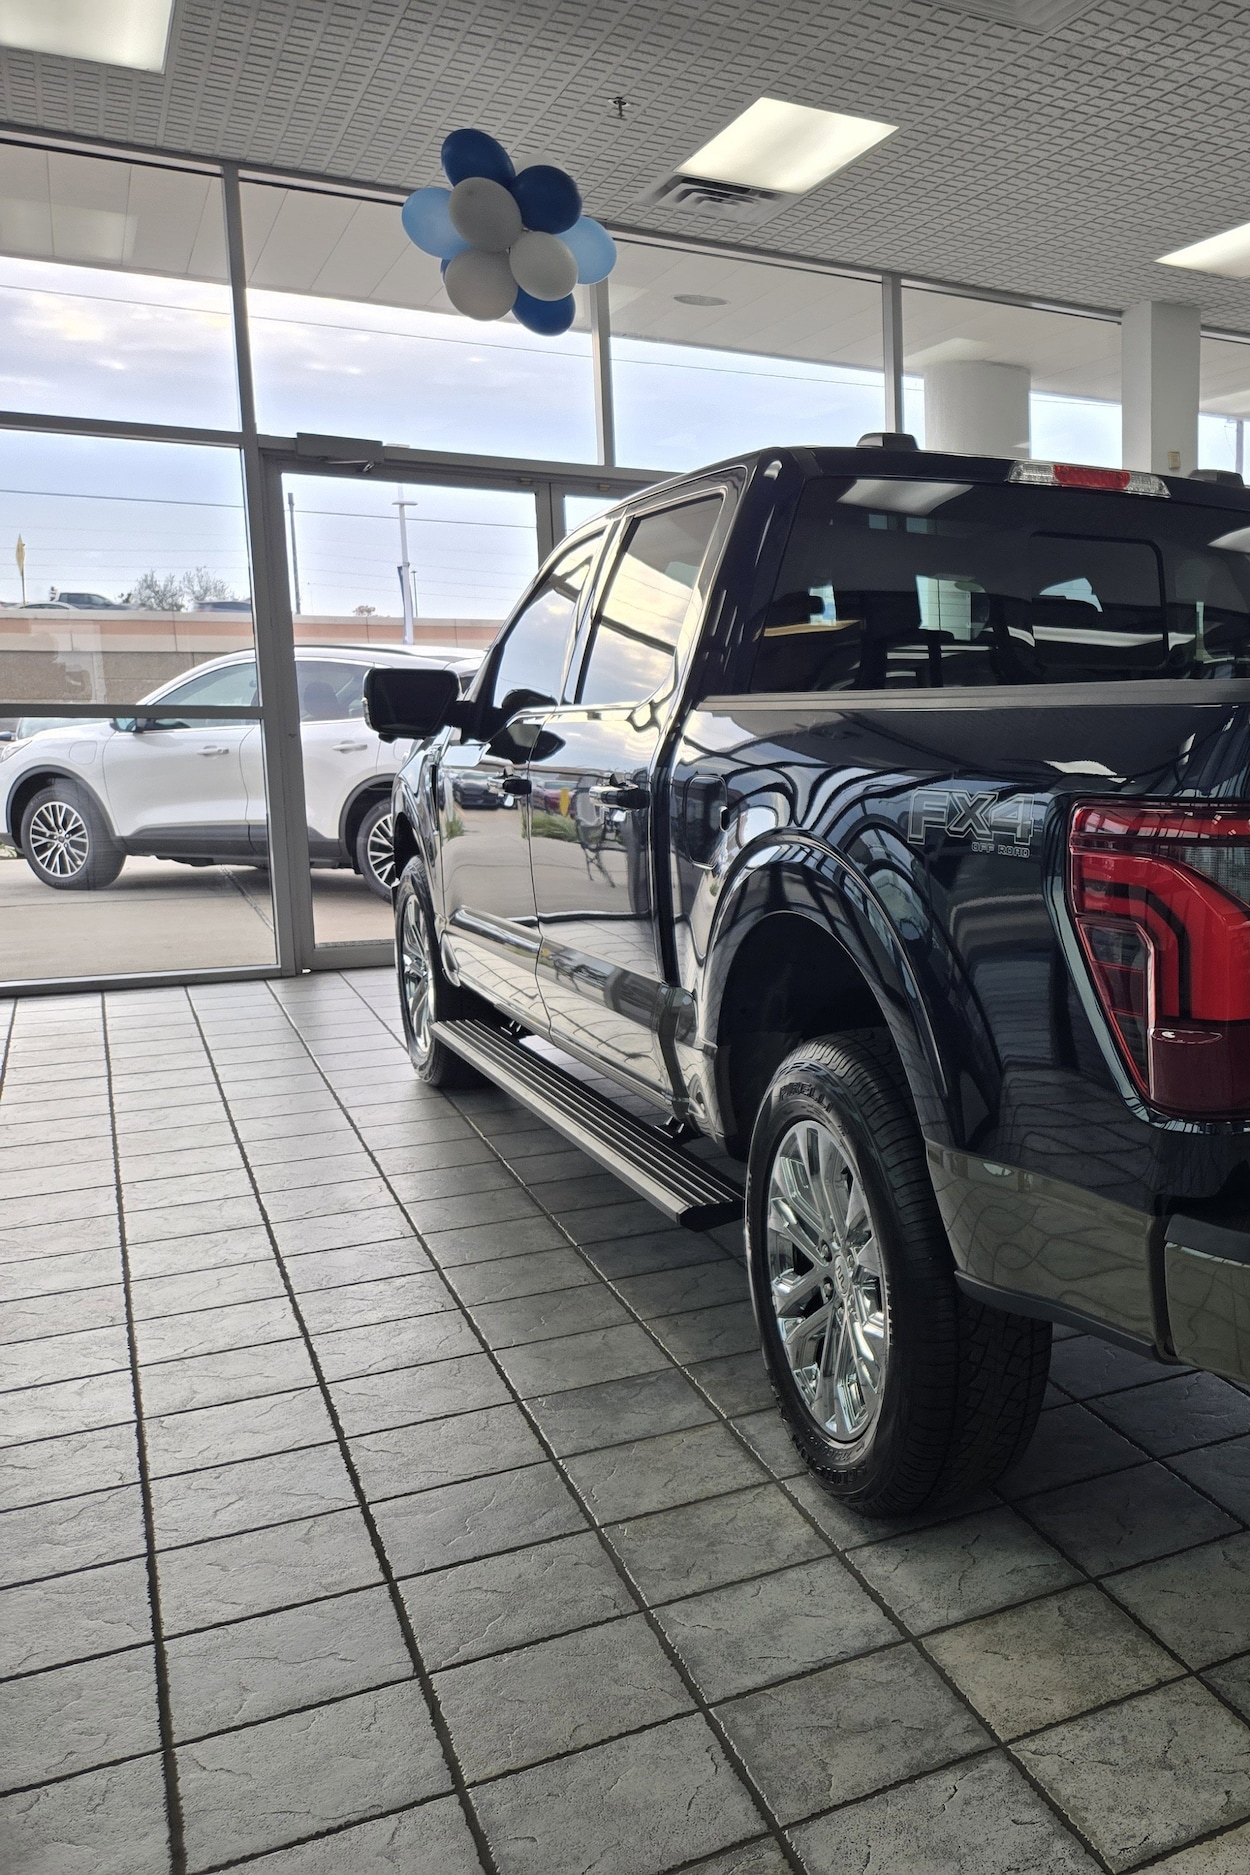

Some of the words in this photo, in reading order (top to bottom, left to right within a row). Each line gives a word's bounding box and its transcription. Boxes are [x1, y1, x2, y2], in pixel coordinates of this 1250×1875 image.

[907, 786, 1034, 846] FX4
[971, 842, 995, 853] OFF
[997, 844, 1031, 858] ROAD
